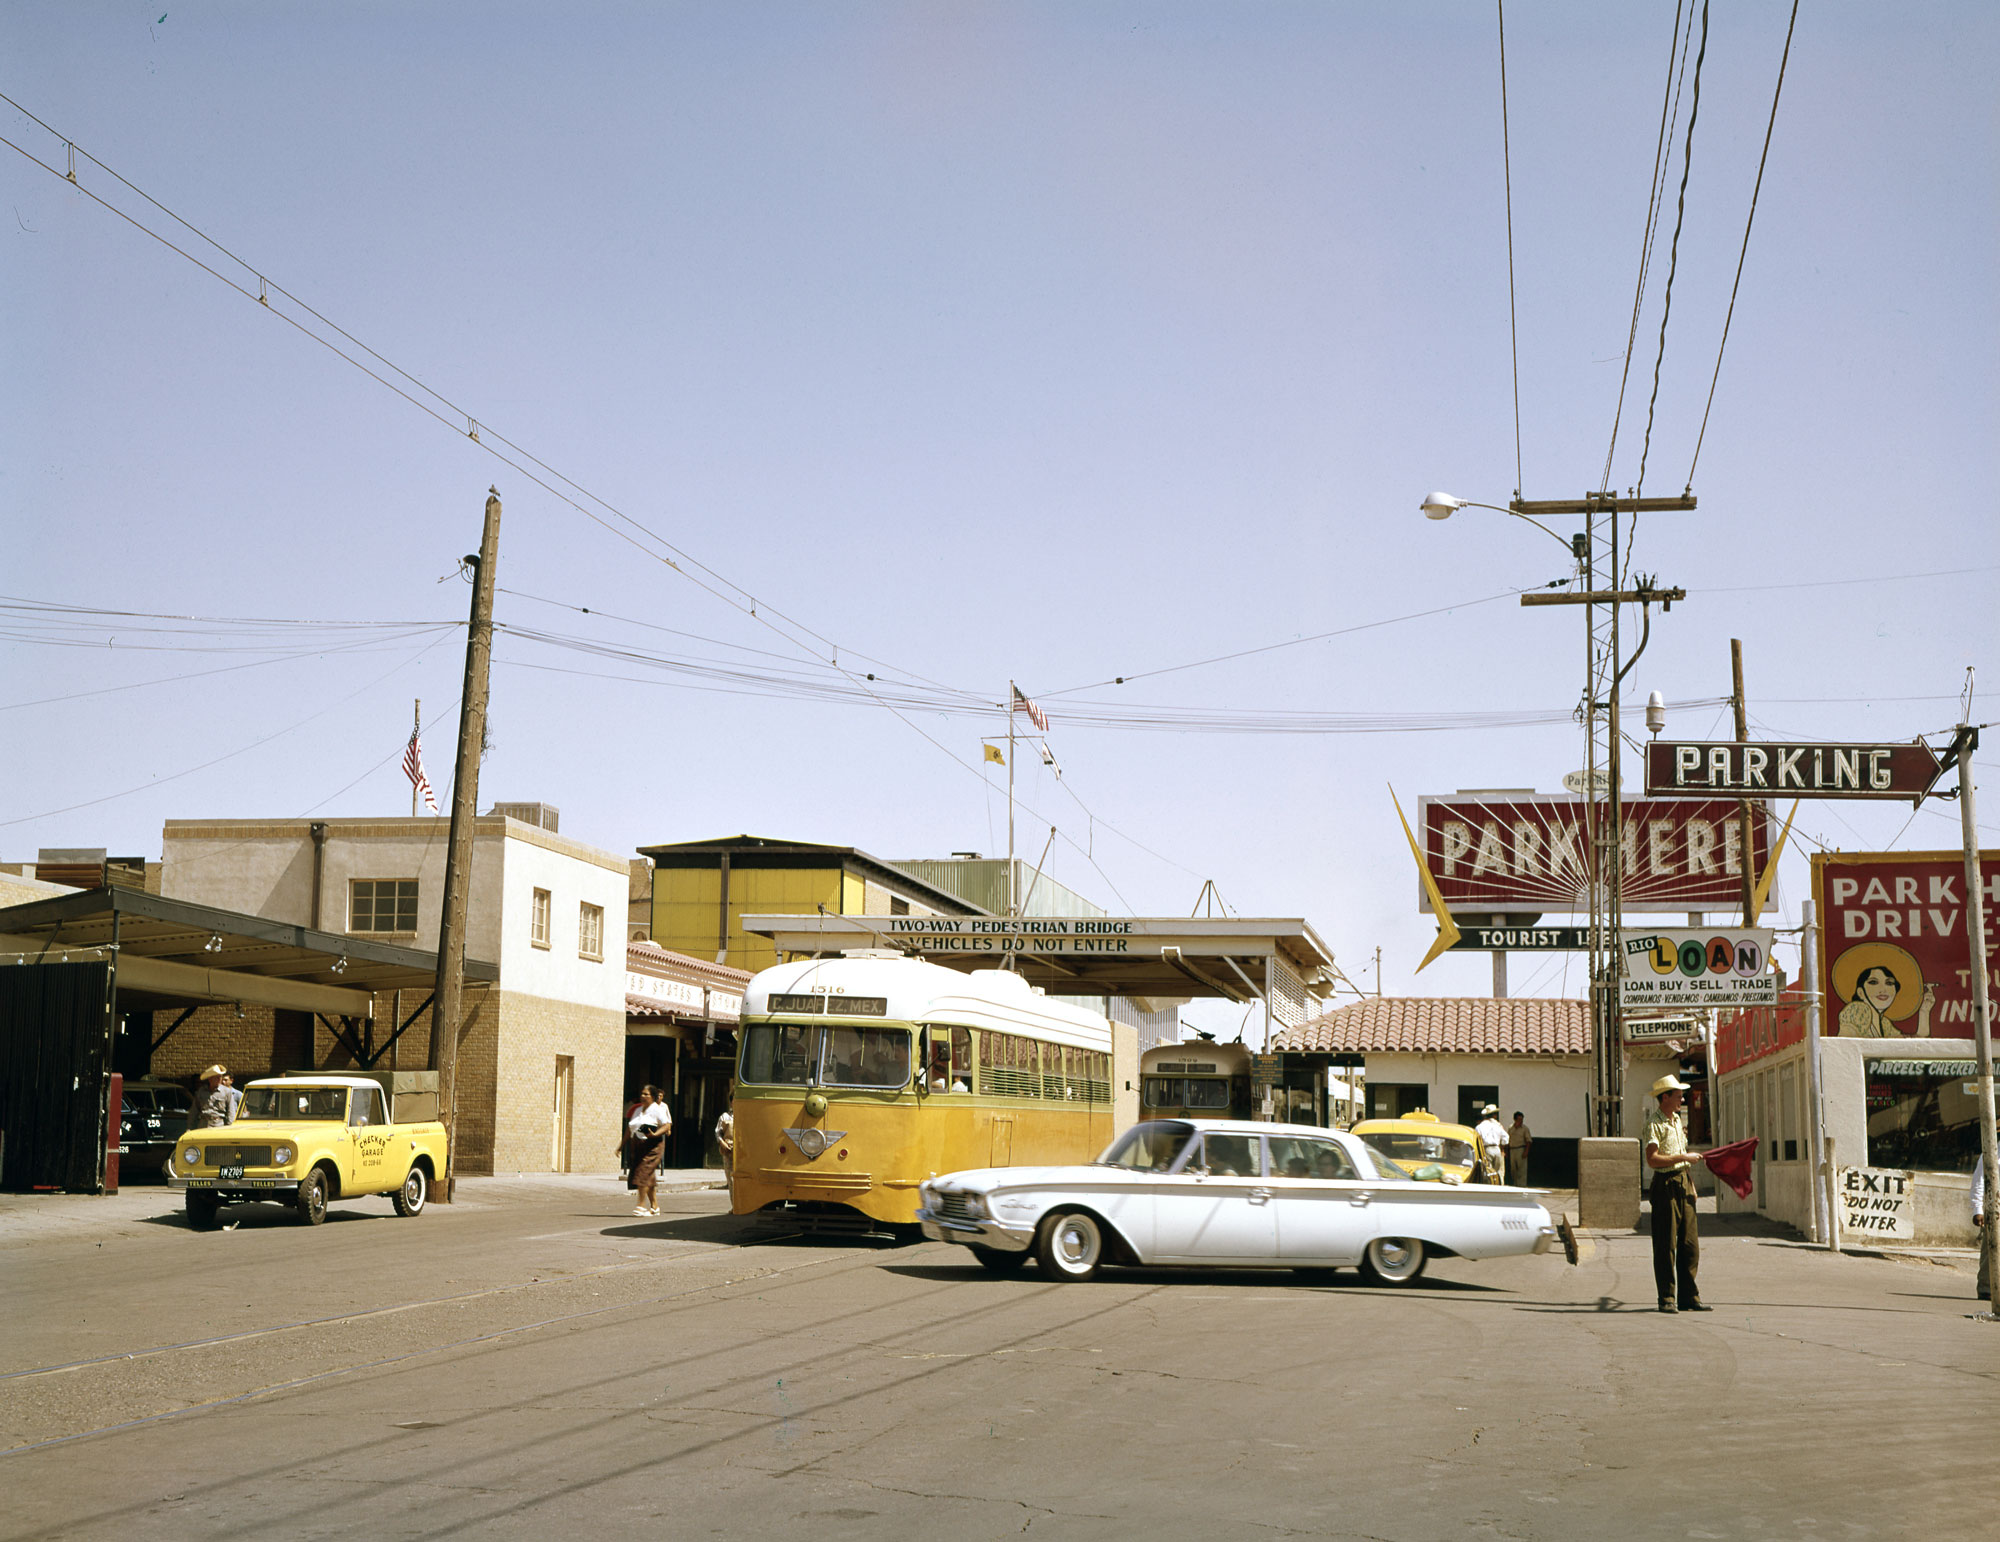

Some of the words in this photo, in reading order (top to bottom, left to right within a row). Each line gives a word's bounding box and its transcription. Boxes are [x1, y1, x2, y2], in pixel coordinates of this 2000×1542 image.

[1676, 746, 1891, 789] PARKING
[1442, 818, 1585, 877] PARK
[1833, 875, 1960, 905] PARK
[890, 920, 963, 931] TWO-WAY
[972, 921, 1068, 933] PEDESTRIAN
[1074, 922, 1133, 933] BRIDGE
[909, 937, 993, 950] VEHICLES
[1002, 938, 1025, 951] DO
[1033, 939, 1066, 951] NOT
[1074, 939, 1128, 952] ENTER
[1479, 931, 1561, 946] TOURIST
[1629, 938, 1655, 952] RIO
[1656, 945, 1756, 971] LOAN
[625, 974, 644, 991] TED
[810, 985, 845, 994] 1516
[1625, 981, 1654, 991] LOAN
[1660, 981, 1683, 991] BUY
[1690, 980, 1723, 990] SELL
[1731, 979, 1773, 989] TRADE
[1624, 994, 1662, 1004] COMPRAMOS
[1664, 993, 1699, 1003] VENDEMOS
[1703, 993, 1739, 1002] CAMBIAMOS
[1741, 992, 1774, 1002] PRESTAMOS
[849, 1000, 883, 1013] MEX.
[1629, 1022, 1692, 1034] TELEPHONE
[1869, 1062, 1925, 1075] PARCELS
[1928, 1062, 1976, 1076] CHECKED
[359, 1135, 386, 1150] CHECKER
[362, 1149, 384, 1157] GARAGE
[1846, 1171, 1907, 1194] EXIT
[1847, 1196, 1869, 1209] DO
[1870, 1198, 1903, 1212] NOT
[1848, 1213, 1897, 1231] ENTER
